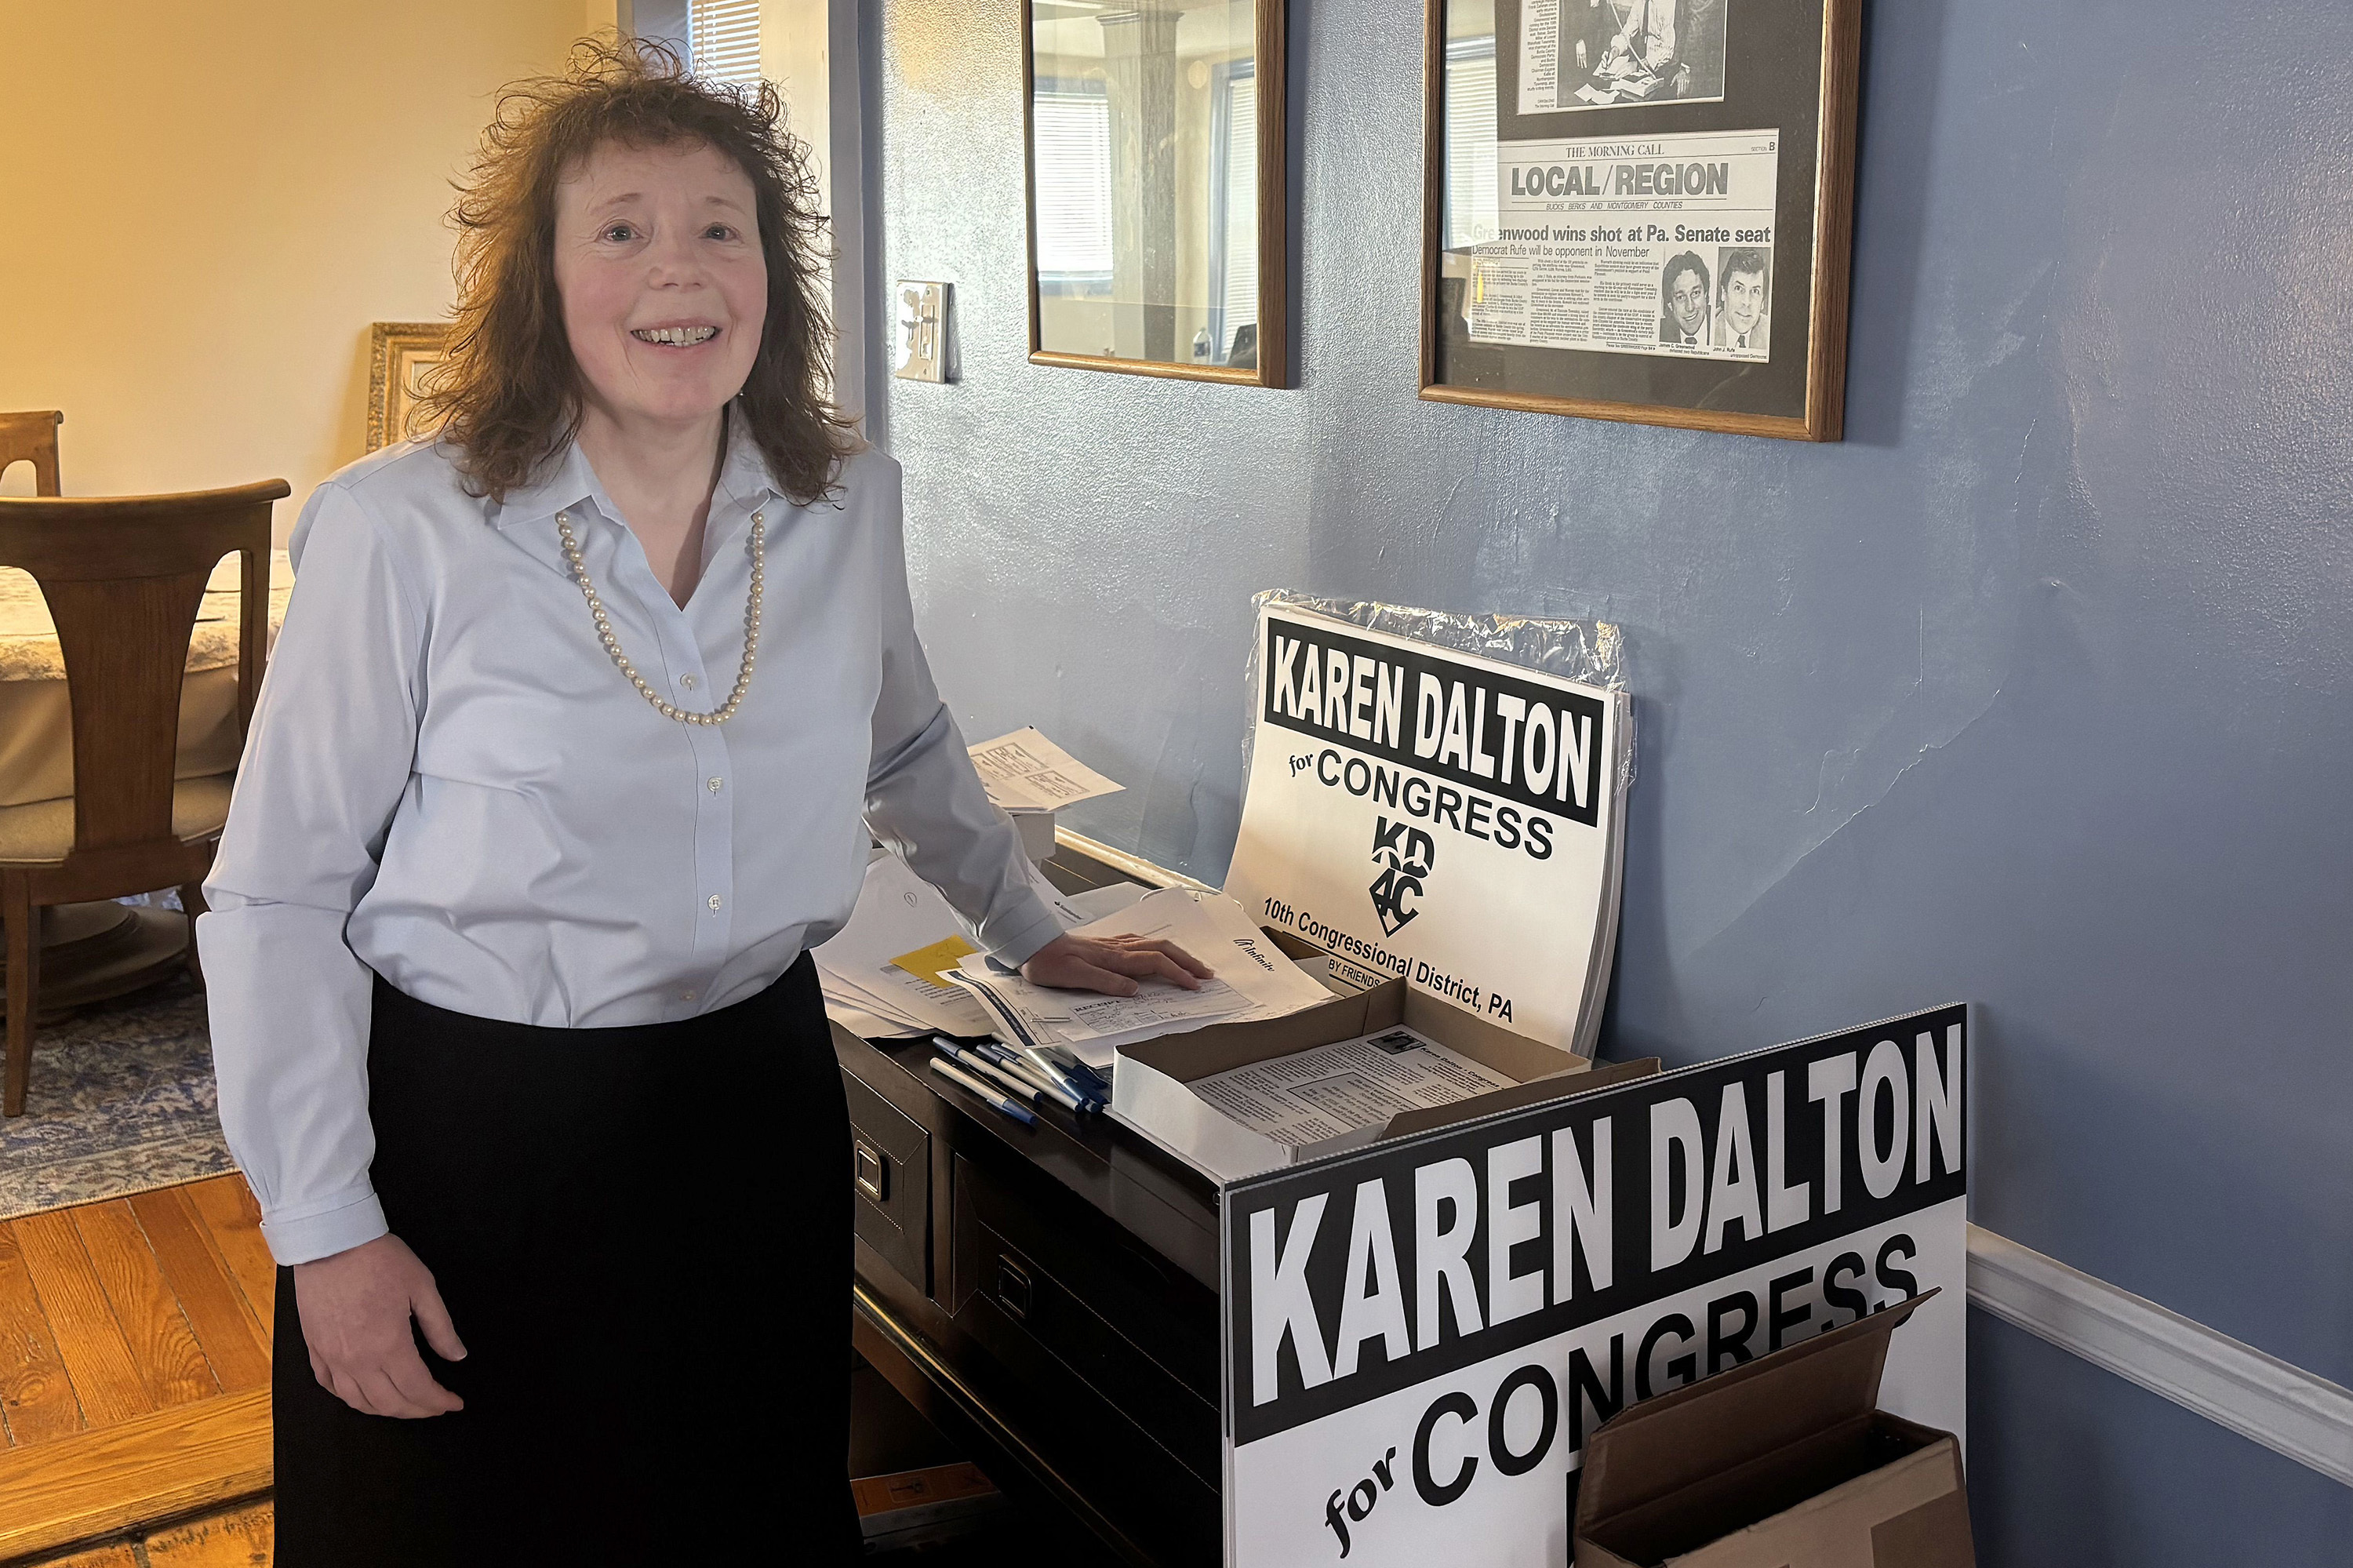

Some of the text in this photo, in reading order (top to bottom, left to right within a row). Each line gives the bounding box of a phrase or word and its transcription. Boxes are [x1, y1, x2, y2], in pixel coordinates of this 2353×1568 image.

[1566, 144, 1664, 158] THE MORNING CALL
[1769, 141, 1776, 151] B
[1653, 201, 1683, 209] COUNTIES
[1552, 225, 1586, 242] wins
[1590, 225, 1622, 242] shot
[1627, 226, 1642, 242] at
[1647, 224, 1670, 242] Pa.
[1675, 224, 1730, 242] Senate
[1734, 226, 1771, 243] seat
[1472, 244, 1650, 259] Democrat Rufe will be opponent in November
[1272, 635, 1591, 809] KAREN DALTON
[1289, 749, 1553, 860] for CONGRESS
[1264, 897, 1513, 1024] 10th Congressional District, PA
[1328, 959, 1380, 988] BY FRIENDS
[1420, 1047, 1441, 1058] Karen
[1441, 1057, 1464, 1070] Dalton
[1467, 1070, 1500, 1089] Congress
[1249, 1023, 1961, 1407] KAREN DALTON
[1324, 1446, 1396, 1559] for
[1412, 1232, 1918, 1507] CONGRESS
